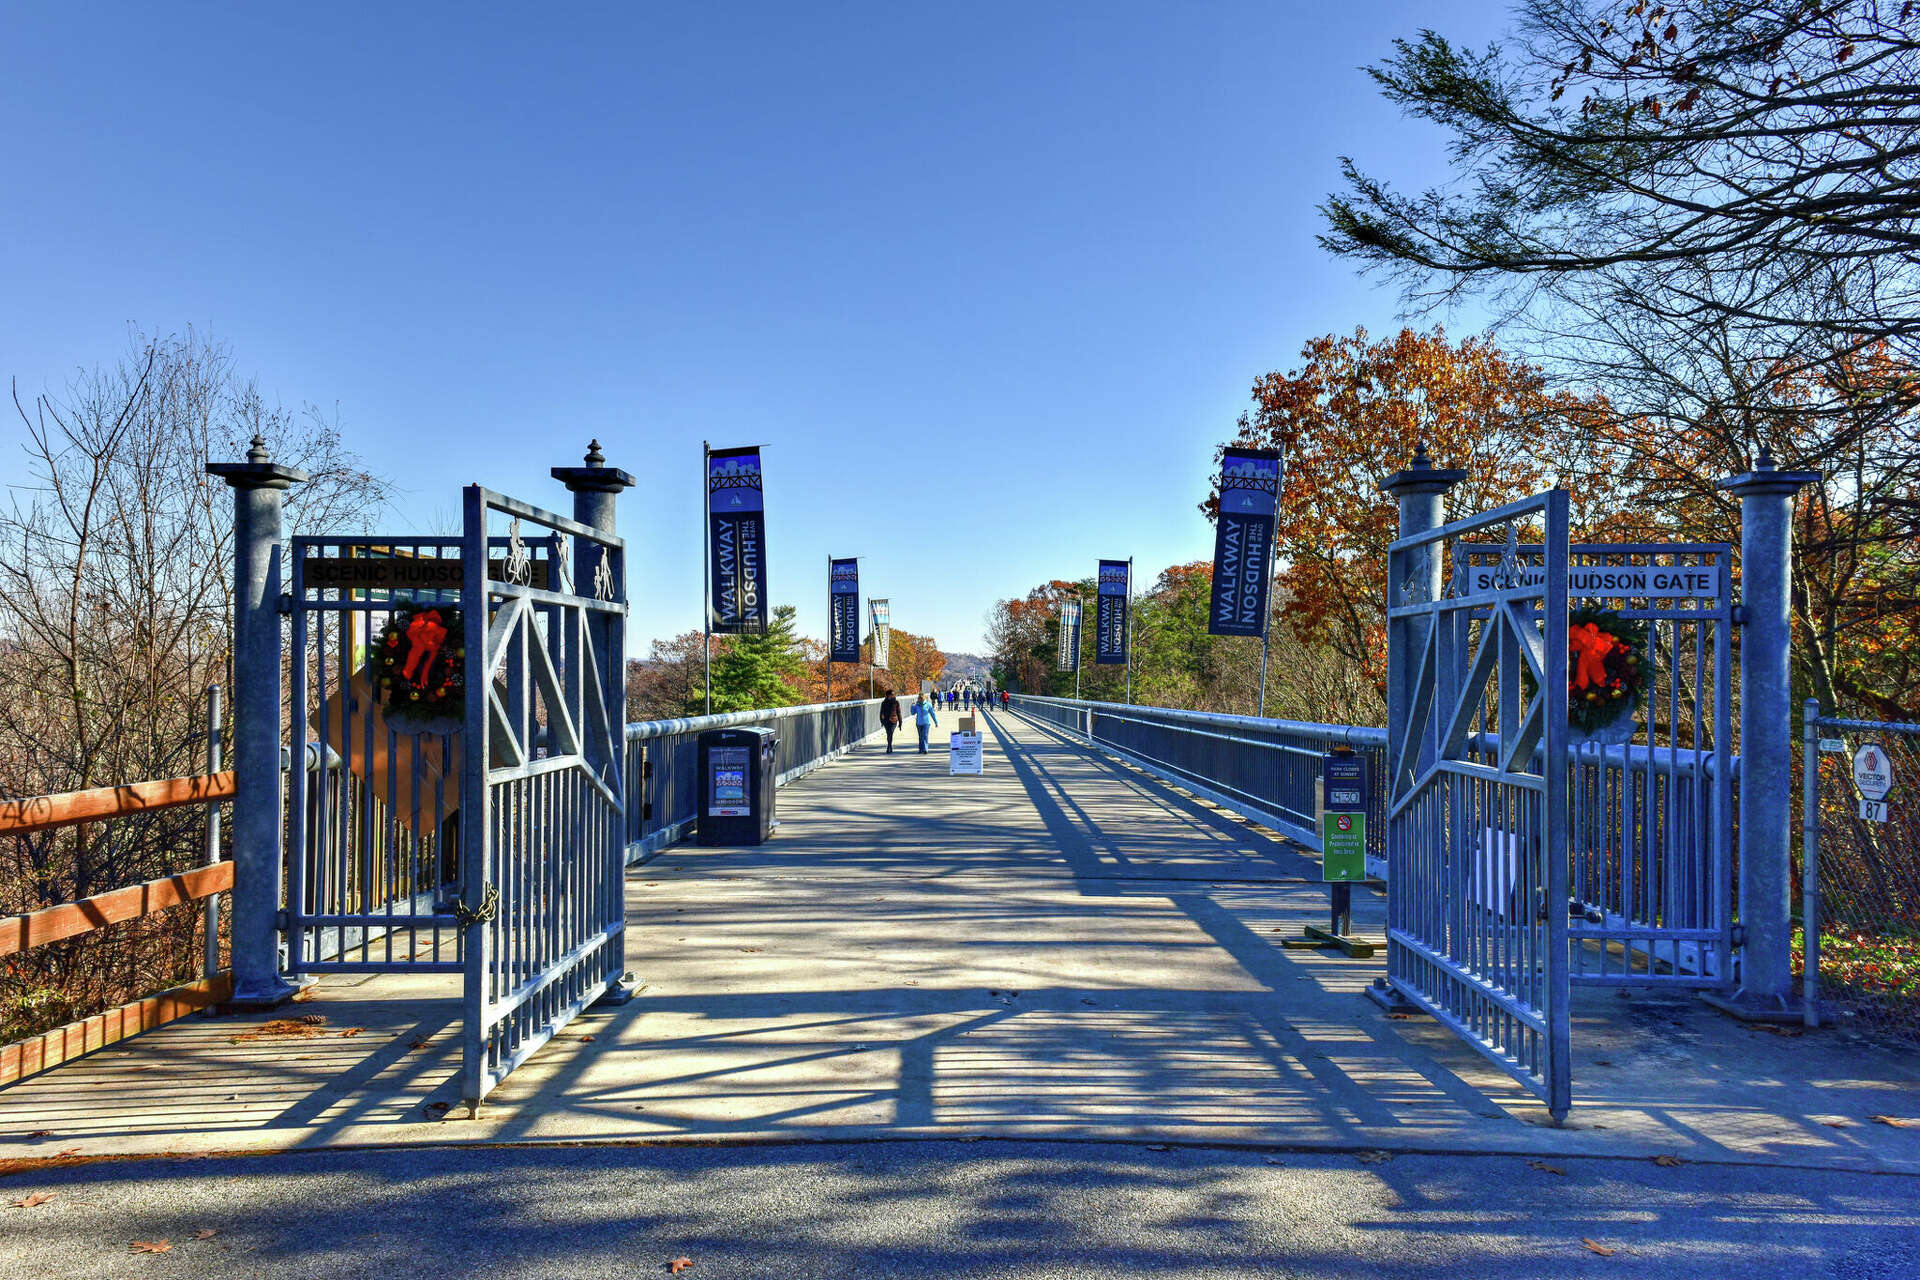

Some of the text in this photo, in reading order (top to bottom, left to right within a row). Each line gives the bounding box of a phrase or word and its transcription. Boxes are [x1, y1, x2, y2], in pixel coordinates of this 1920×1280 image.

[312, 564, 388, 582] SCENIC
[394, 565, 465, 582] HUDSO
[719, 520, 736, 620] WALKWAY
[742, 521, 758, 620] THE HUDSON
[1218, 519, 1241, 621] WALKWAY
[1242, 523, 1262, 623] THE HUDSON
[1653, 574, 1710, 590] GATE
[834, 595, 843, 651] WALKWAY
[846, 606, 855, 651] HUDSON
[1100, 596, 1110, 653] WALKWAY
[1113, 609, 1122, 653] HUDSON
[1858, 772, 1886, 780] VECTOR
[1866, 802, 1880, 820] 87
